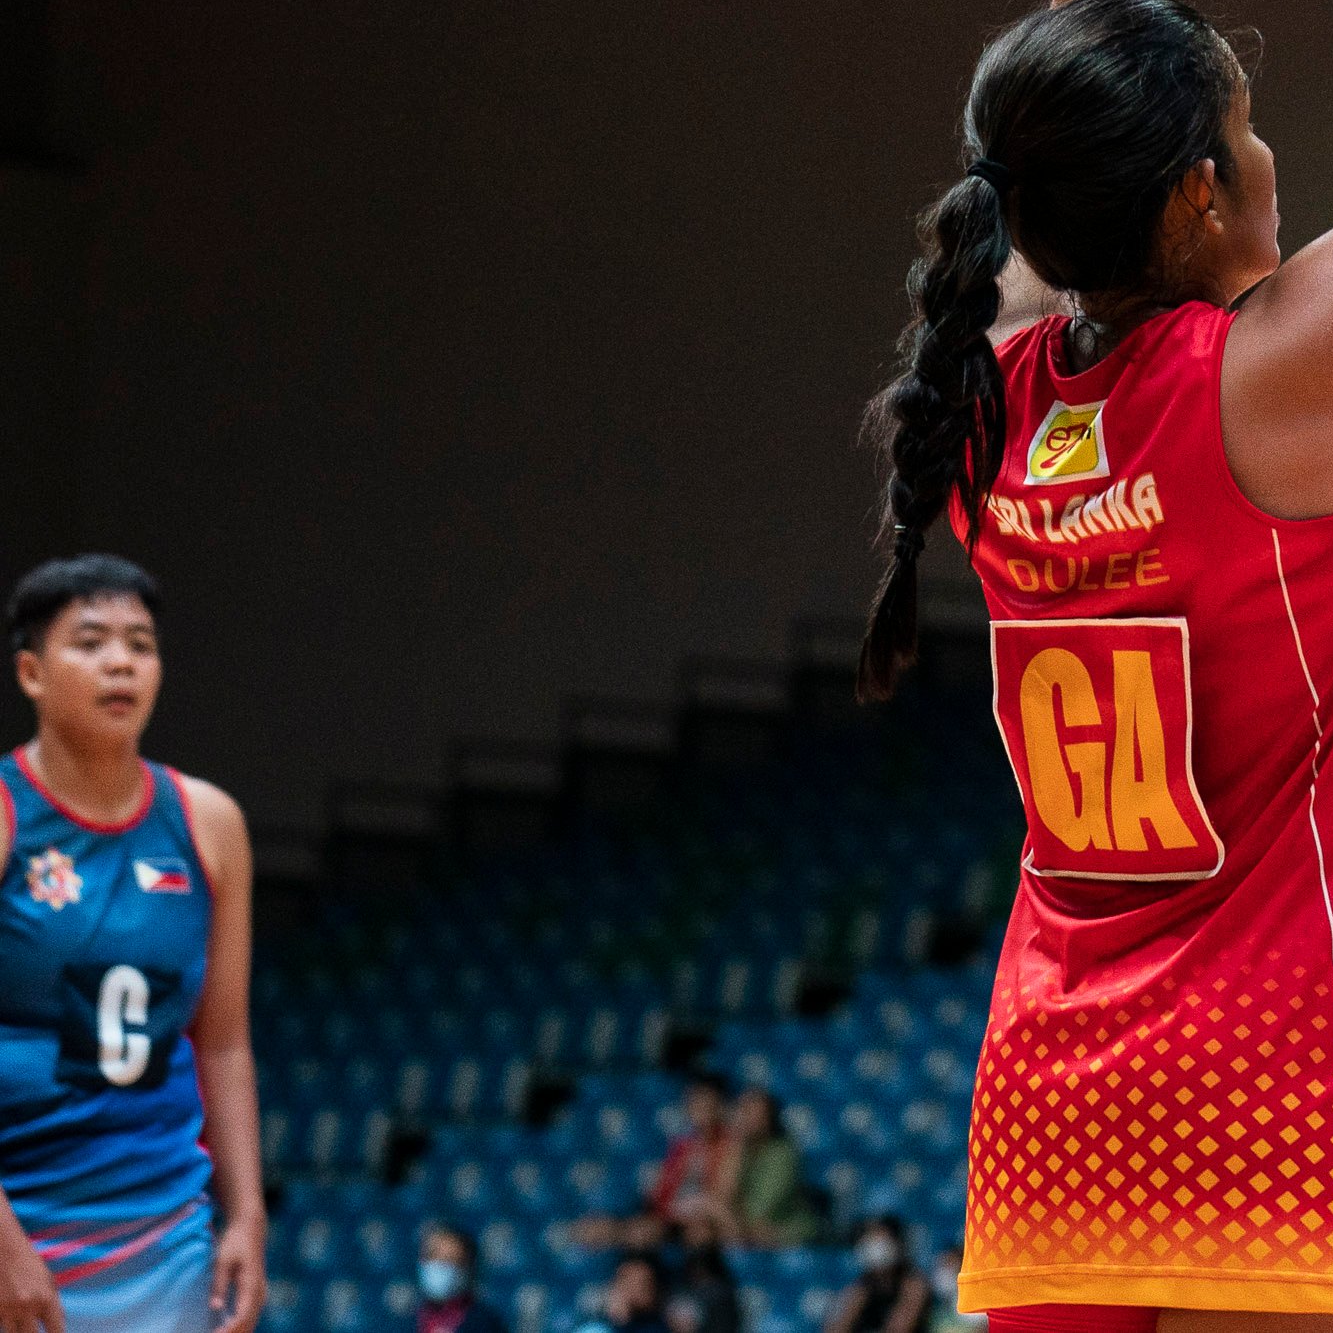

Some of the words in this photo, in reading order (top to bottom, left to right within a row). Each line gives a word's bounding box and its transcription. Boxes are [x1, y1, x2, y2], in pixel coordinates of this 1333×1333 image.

[1039, 472, 1164, 545] LANKA
[1006, 549, 1170, 593] DULEE
[1019, 647, 1198, 853] GA
[97, 964, 151, 1086] C
